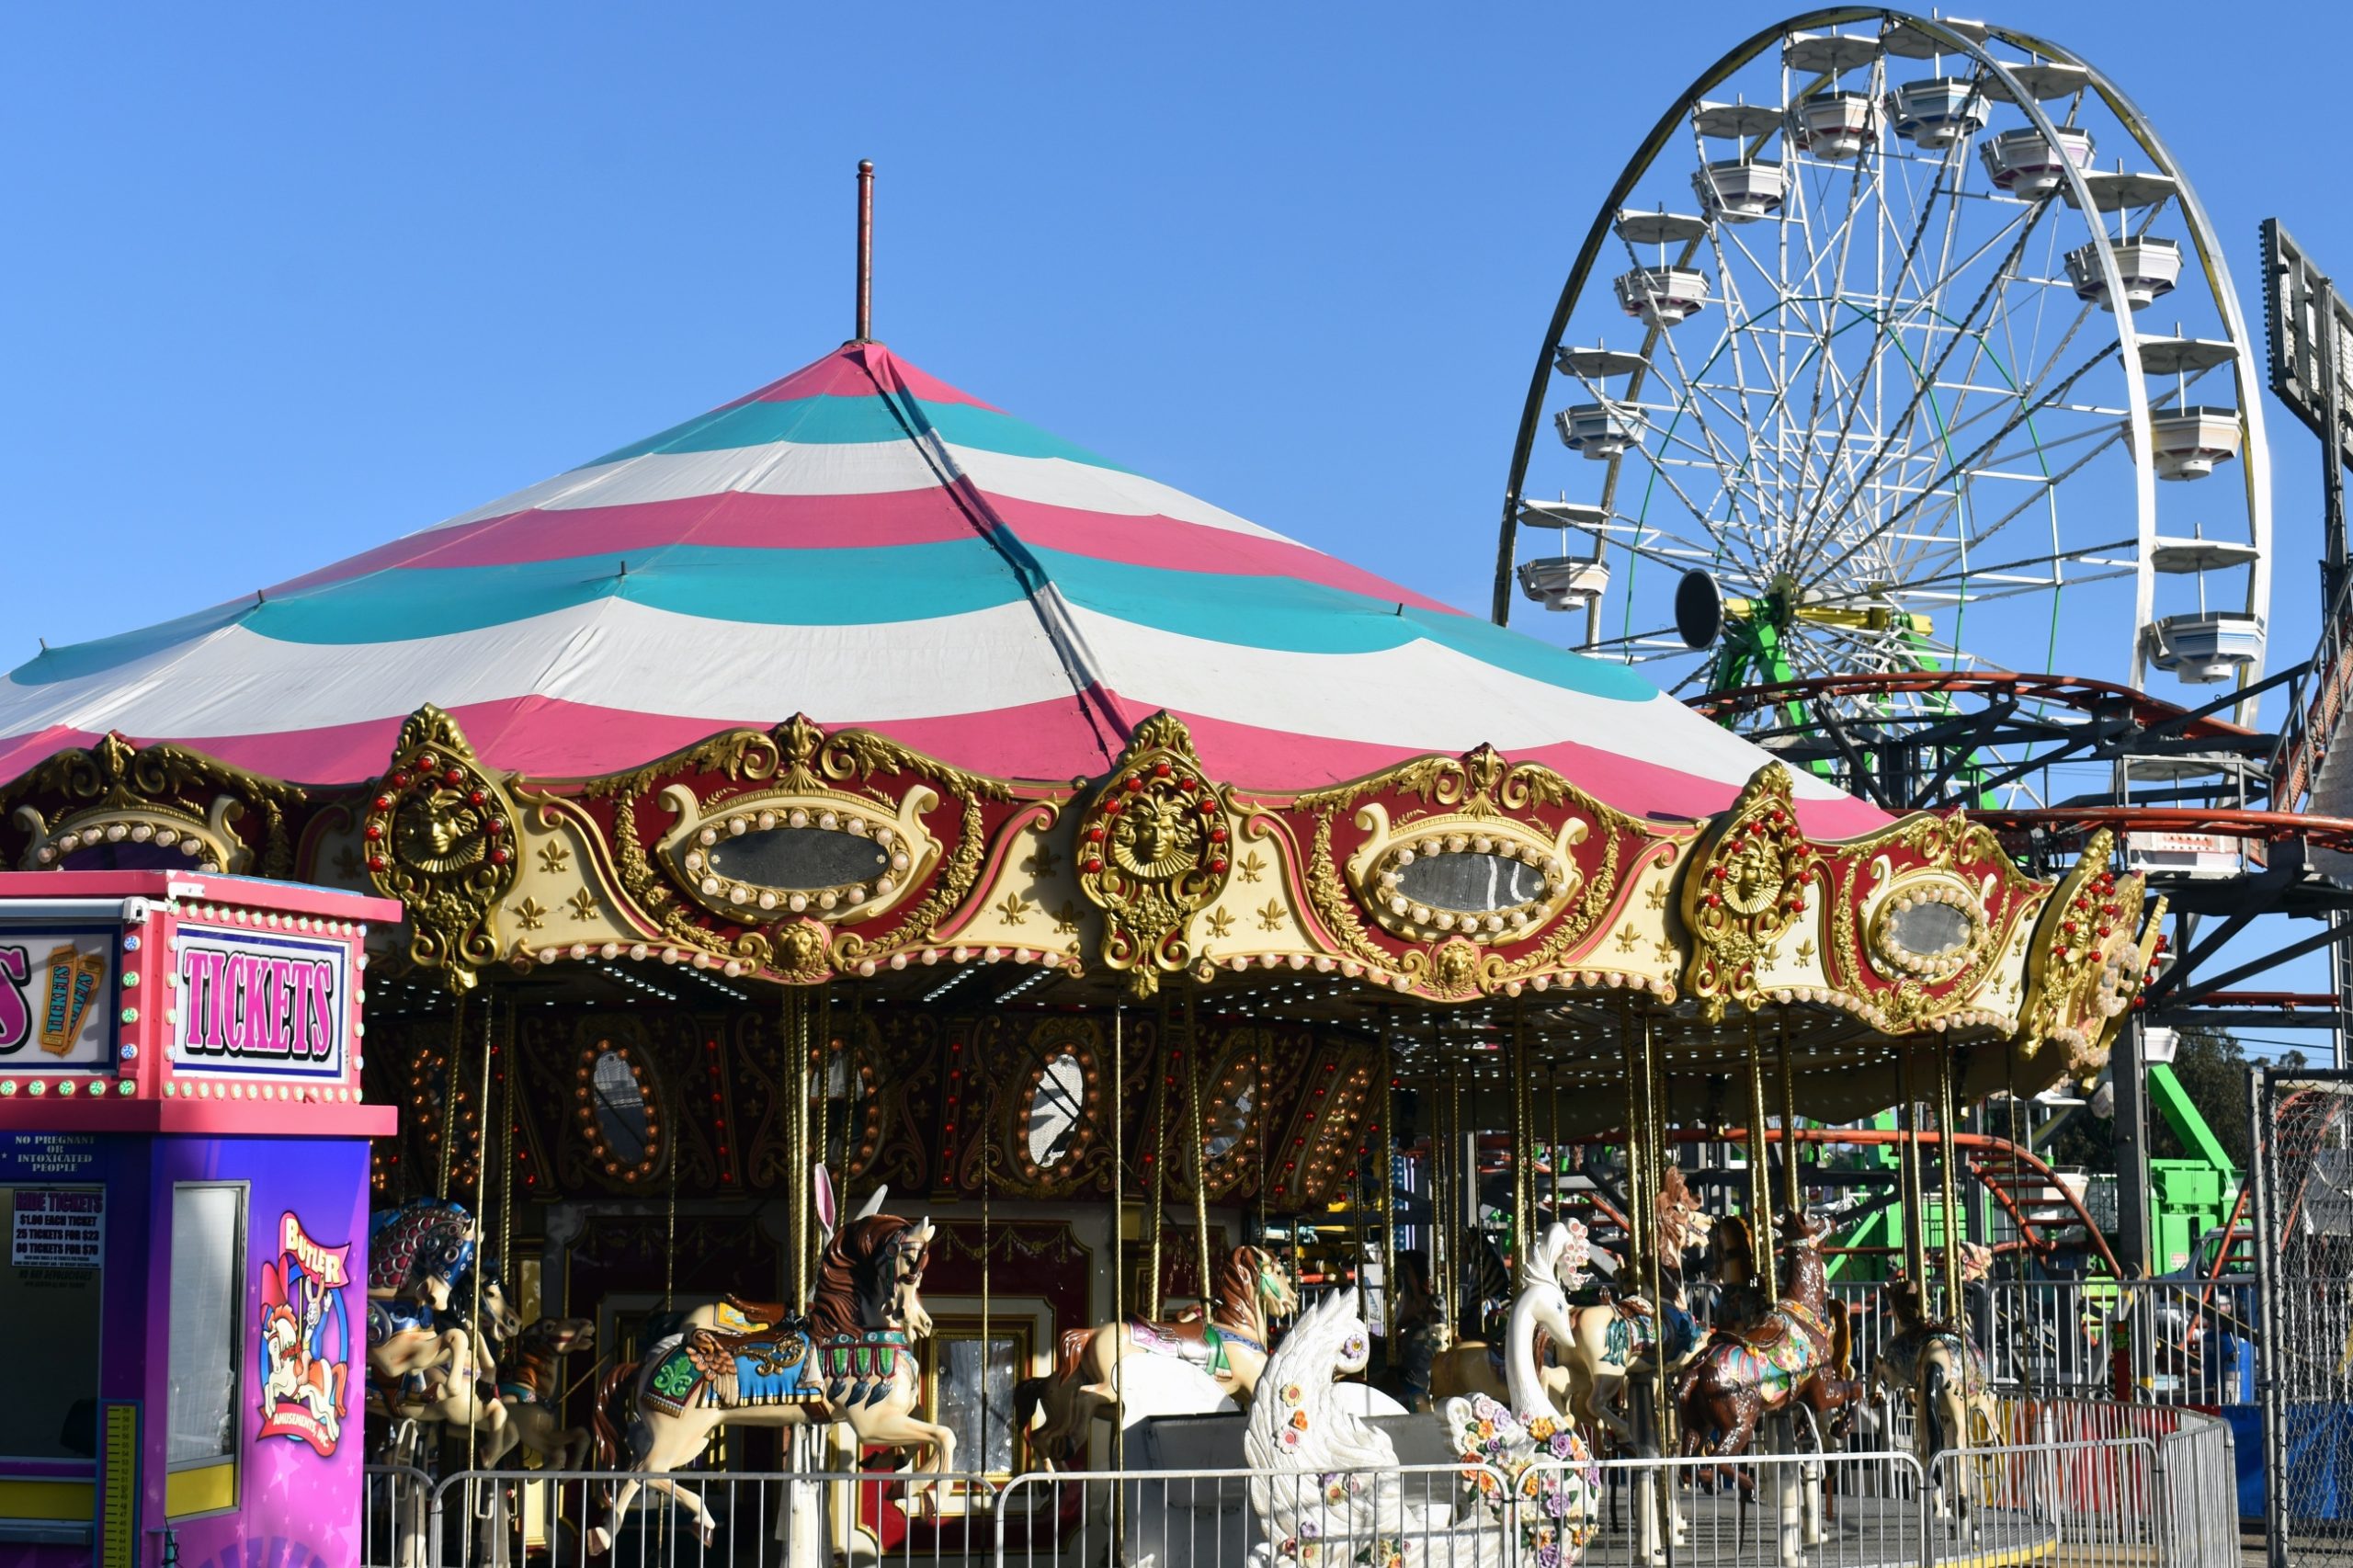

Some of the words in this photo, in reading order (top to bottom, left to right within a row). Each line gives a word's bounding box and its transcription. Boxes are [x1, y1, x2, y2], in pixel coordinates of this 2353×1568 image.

[46, 965, 71, 1032] TICKETS
[184, 948, 334, 1060] TICKETS
[16, 1136, 31, 1144] NO
[34, 1136, 95, 1144] PREGNANT
[47, 1145, 64, 1153] OR
[17, 1154, 93, 1163] INTOXICATED
[32, 1164, 78, 1172] PEOPLE
[16, 1192, 46, 1211] RIDE
[48, 1192, 103, 1213] TICKETS
[44, 1215, 66, 1226] EACH
[68, 1216, 97, 1227] TICKET
[29, 1229, 63, 1240] TICKETS
[64, 1230, 81, 1240] FOR
[29, 1243, 63, 1254] TICKETS
[64, 1244, 81, 1255] FOR
[286, 1218, 340, 1284] BUTLER
